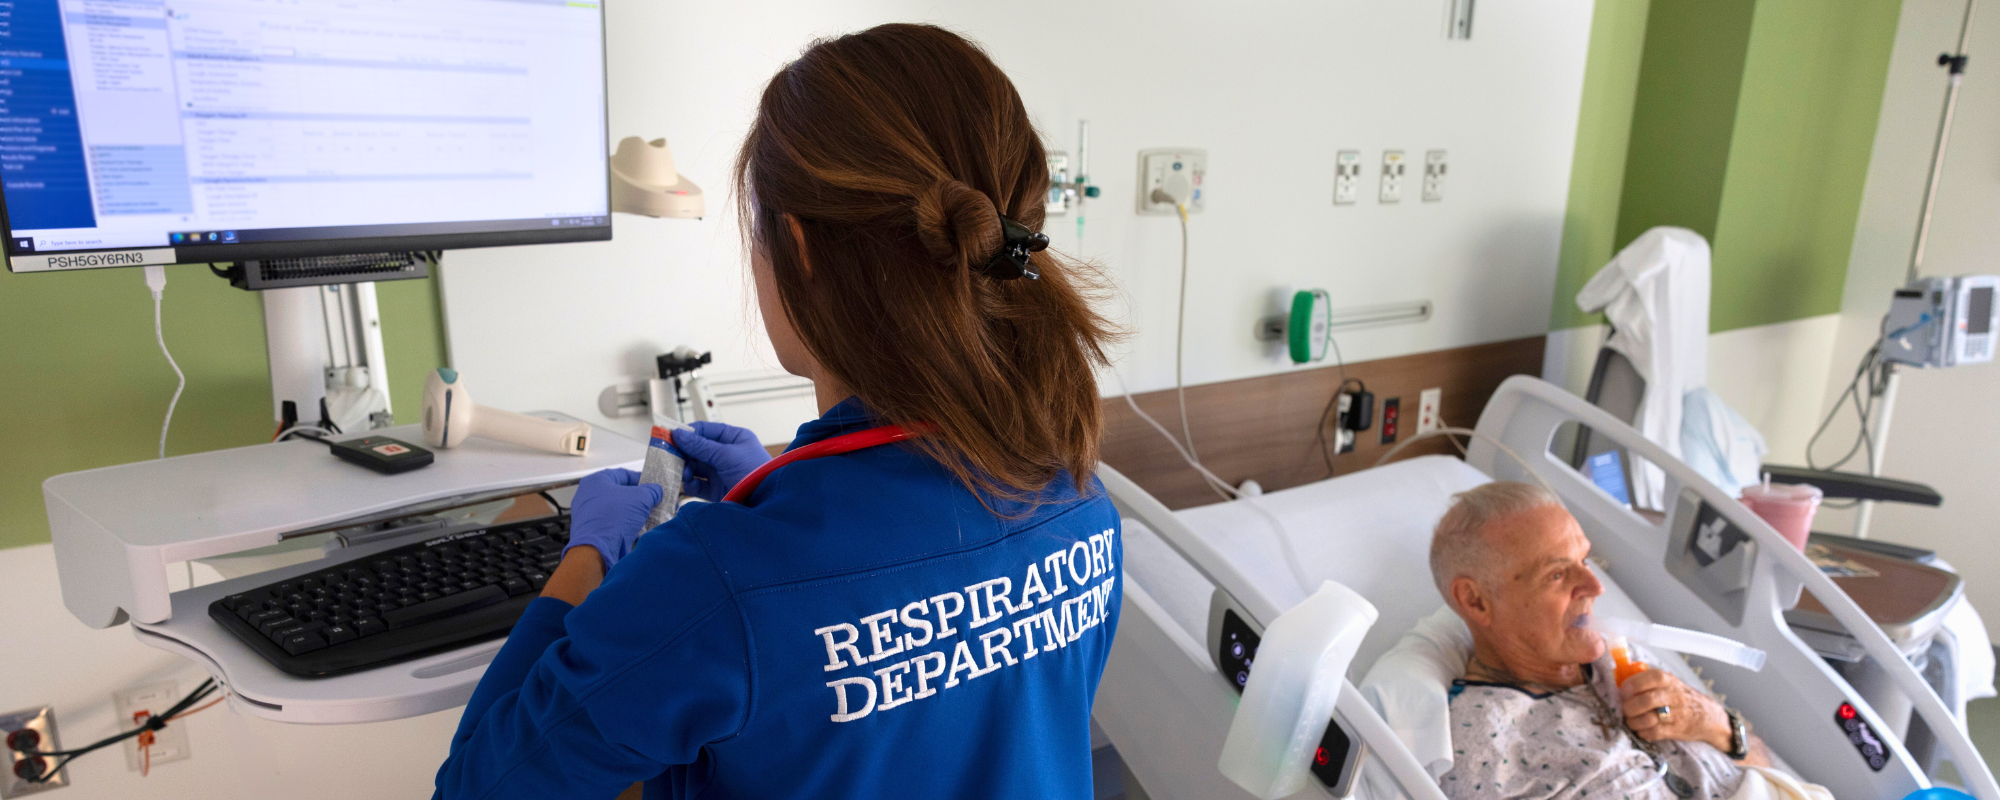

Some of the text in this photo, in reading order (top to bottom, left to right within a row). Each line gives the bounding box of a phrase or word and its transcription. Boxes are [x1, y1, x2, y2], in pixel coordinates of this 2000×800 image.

[47, 252, 144, 268] PSH5GY6RN3
[814, 528, 1115, 672] RESPIRATORY
[826, 576, 1115, 723] DEPARTMENT
